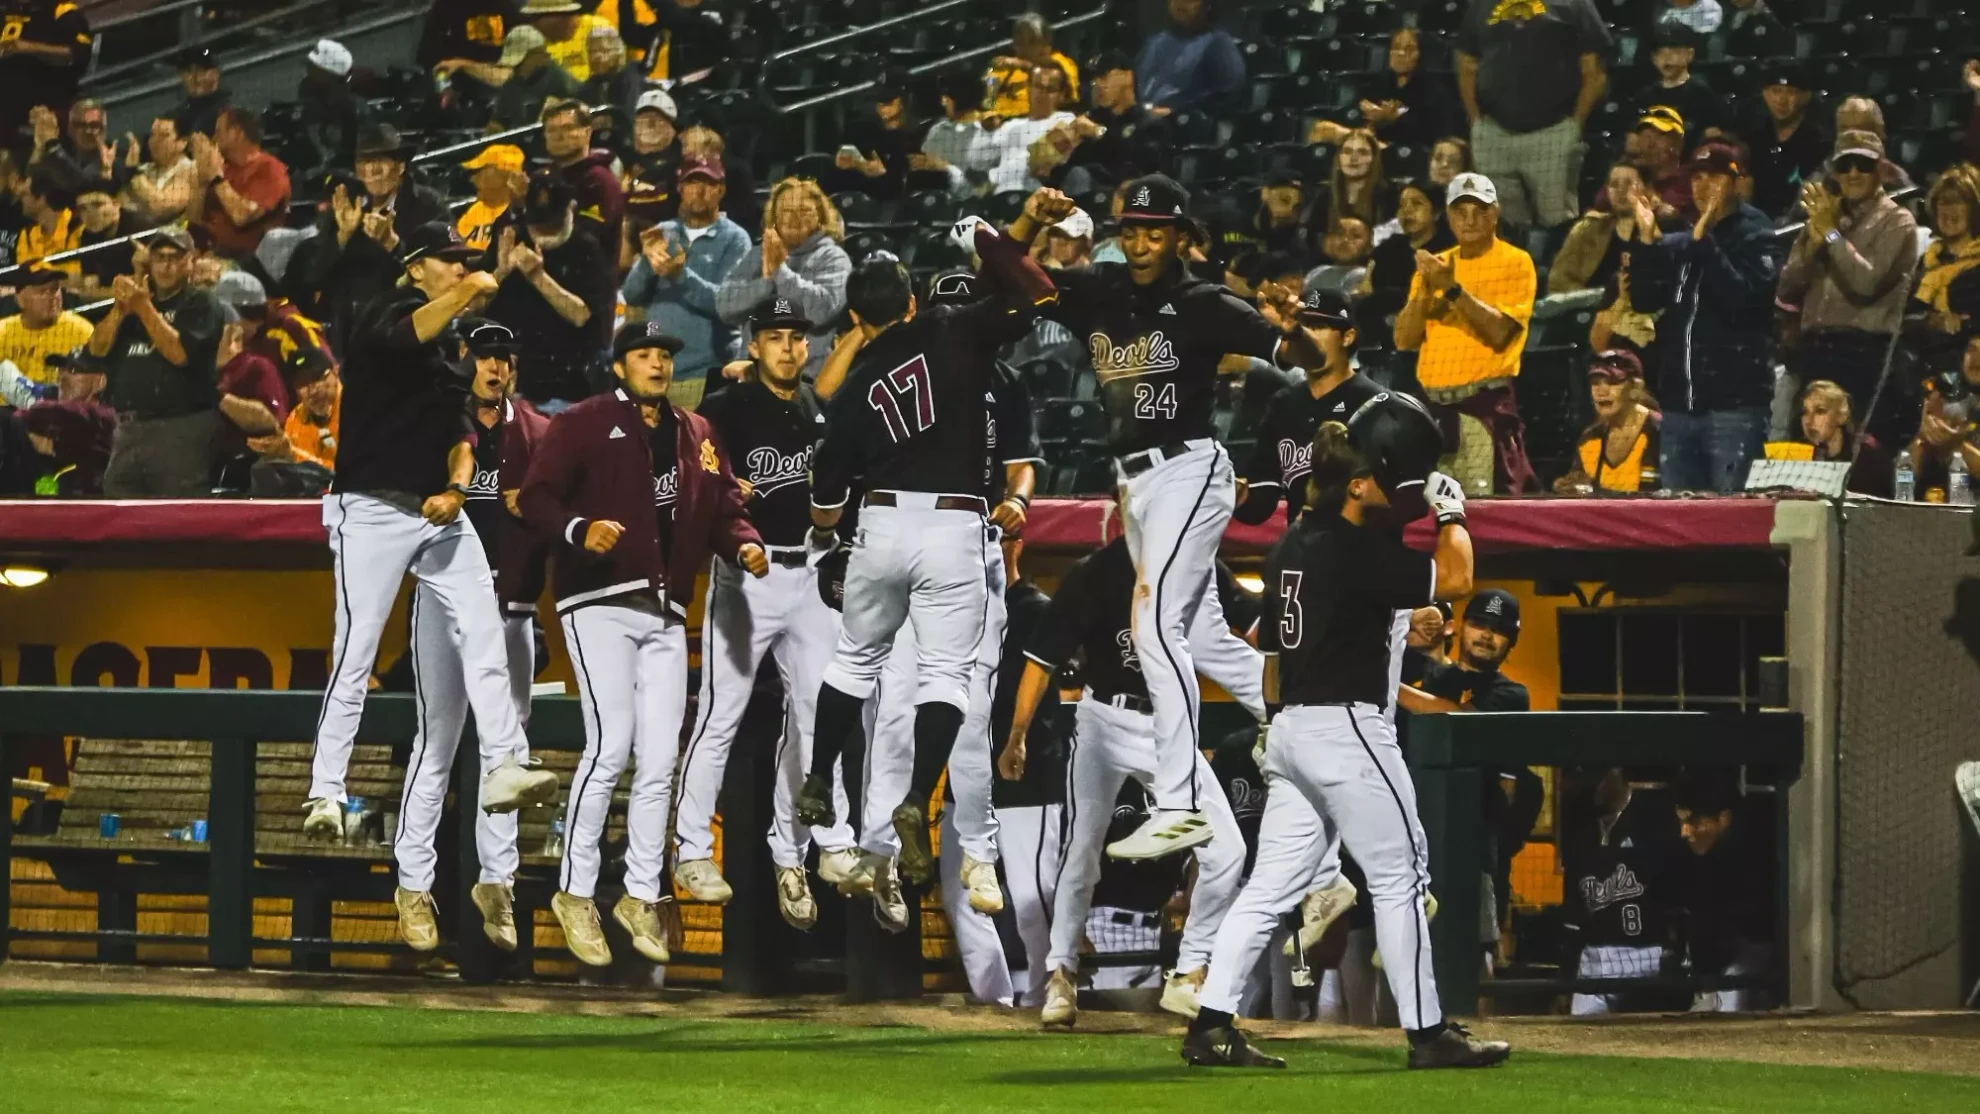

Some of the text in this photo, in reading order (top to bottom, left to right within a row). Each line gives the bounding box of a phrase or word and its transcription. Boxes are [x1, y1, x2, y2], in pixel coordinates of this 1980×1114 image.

[1090, 331, 1178, 378] Devils
[868, 353, 936, 443] 17
[1134, 383, 1178, 419] 24
[1280, 570, 1303, 649] 3
[1622, 904, 1642, 936] 8
